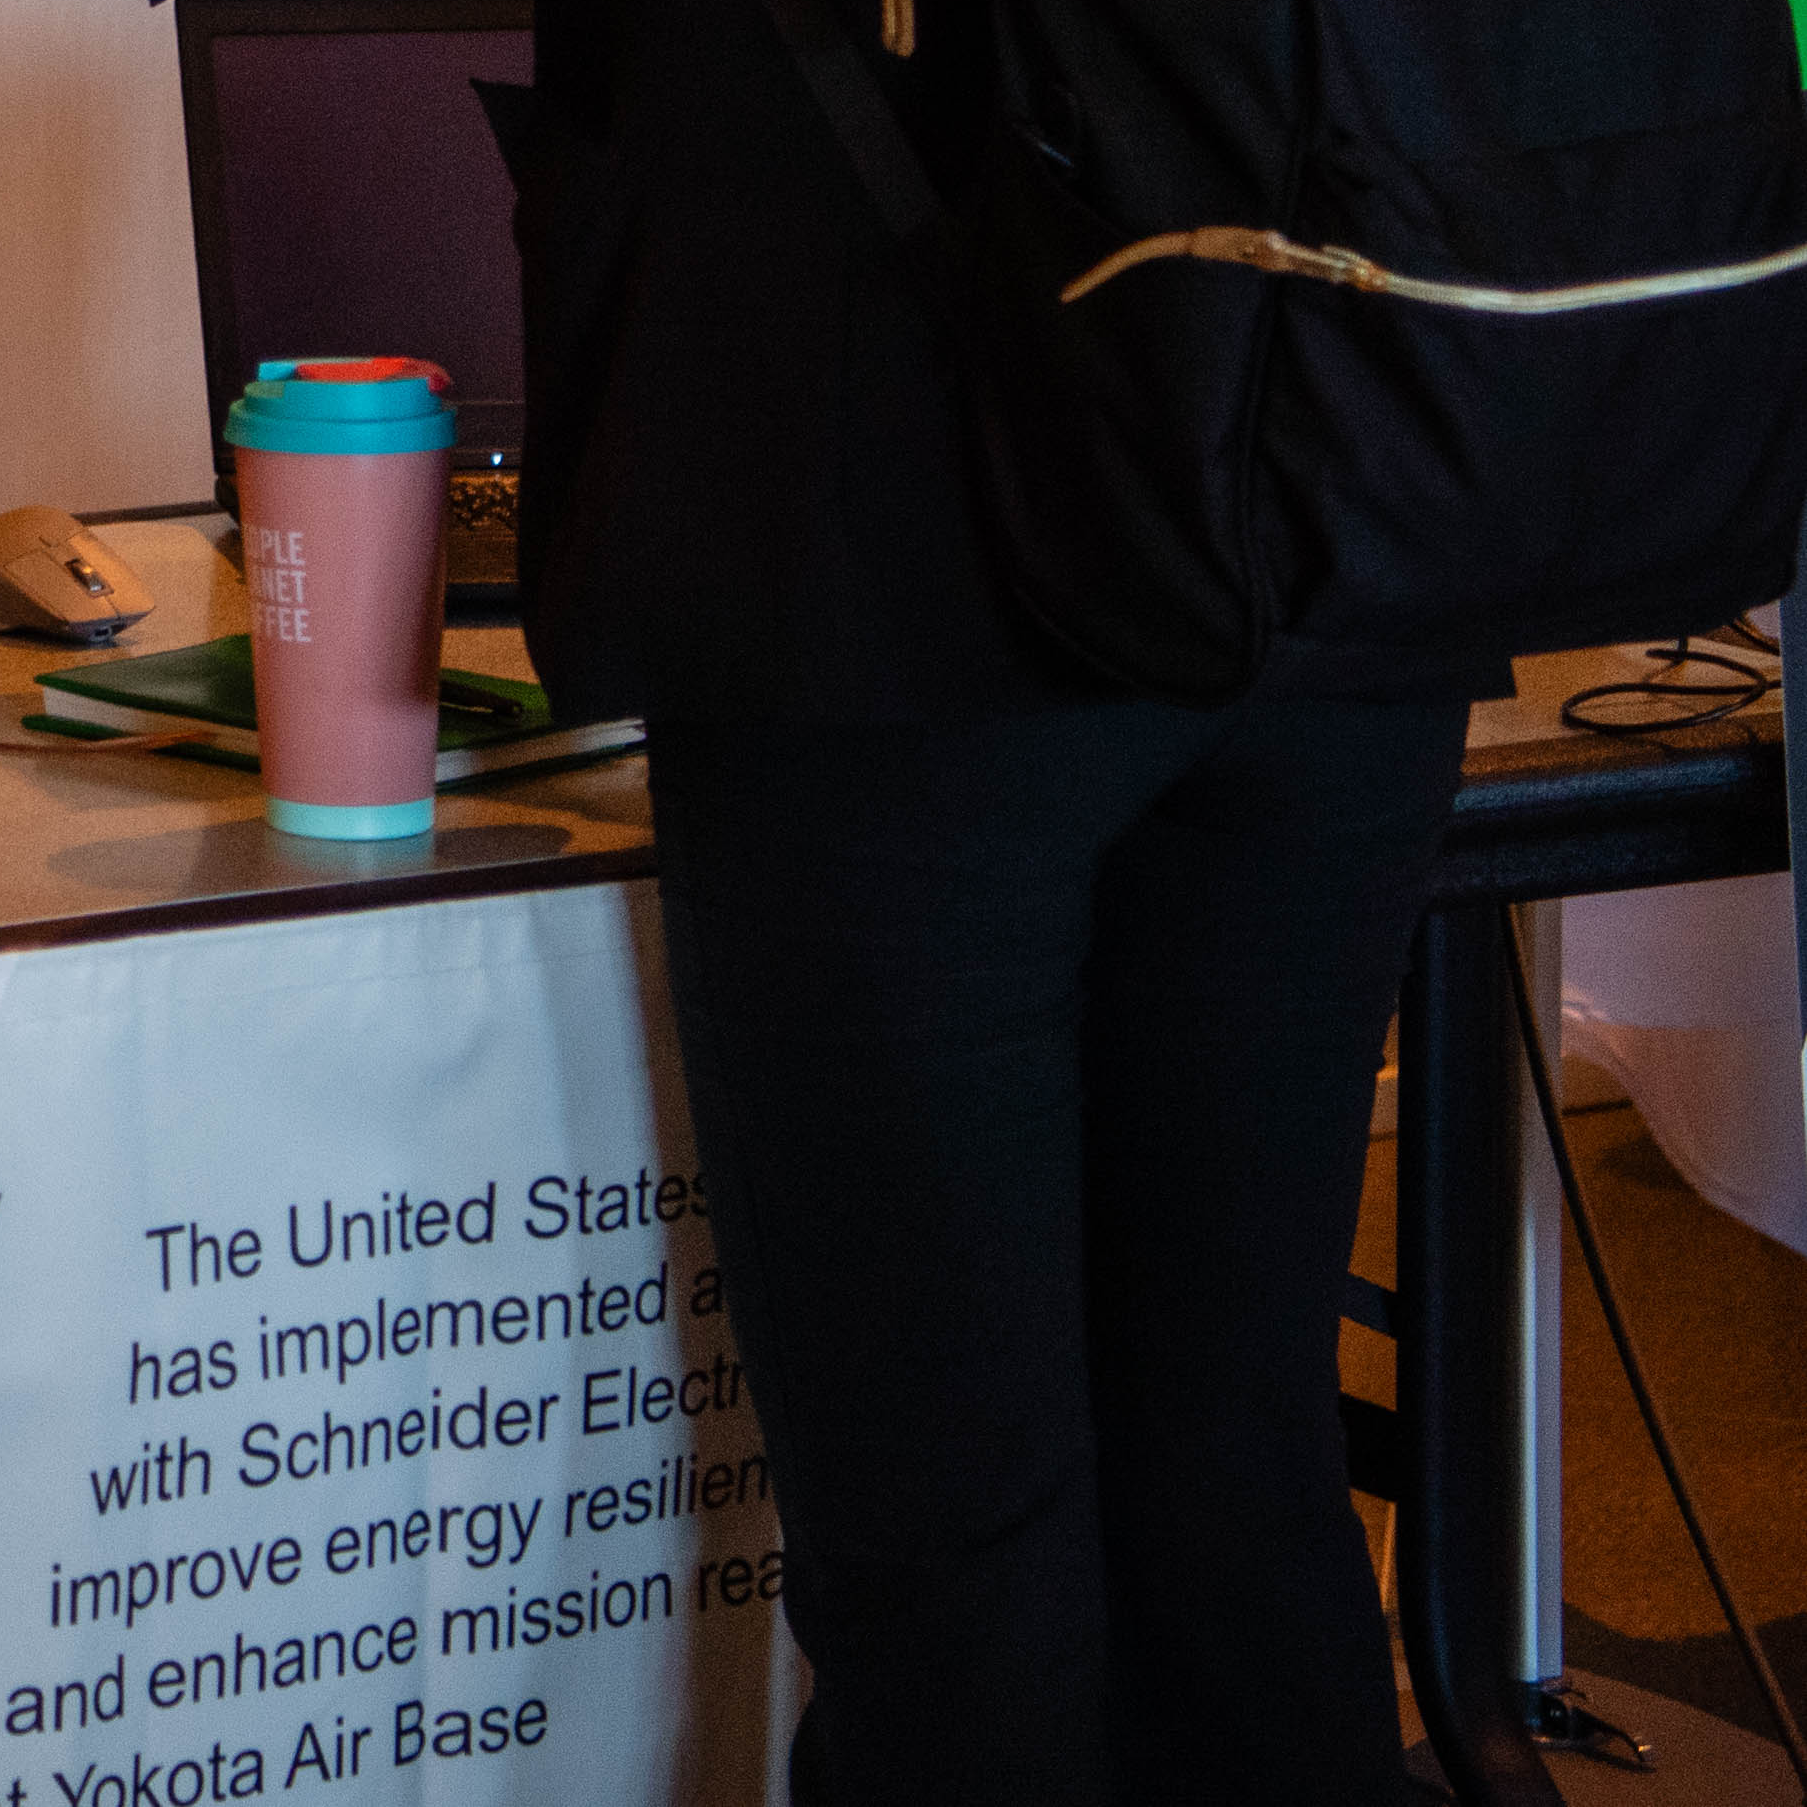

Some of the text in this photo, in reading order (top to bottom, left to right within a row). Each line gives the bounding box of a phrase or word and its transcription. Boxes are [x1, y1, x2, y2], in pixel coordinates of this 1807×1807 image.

[146, 1225, 263, 1293] The
[288, 1183, 496, 1269] United
[129, 1339, 238, 1404] has
[259, 1262, 668, 1384] implemented
[90, 1440, 212, 1517] with
[237, 1385, 559, 1488] Schneider
[50, 1533, 301, 1629] improve
[325, 1495, 541, 1569] energy
[4, 1655, 124, 1736] and
[147, 1615, 418, 1710] enhance
[440, 1566, 673, 1657] mission
[52, 1741, 264, 1807] Yokota
[284, 1716, 372, 1789] Air
[393, 1690, 549, 1767] Base
